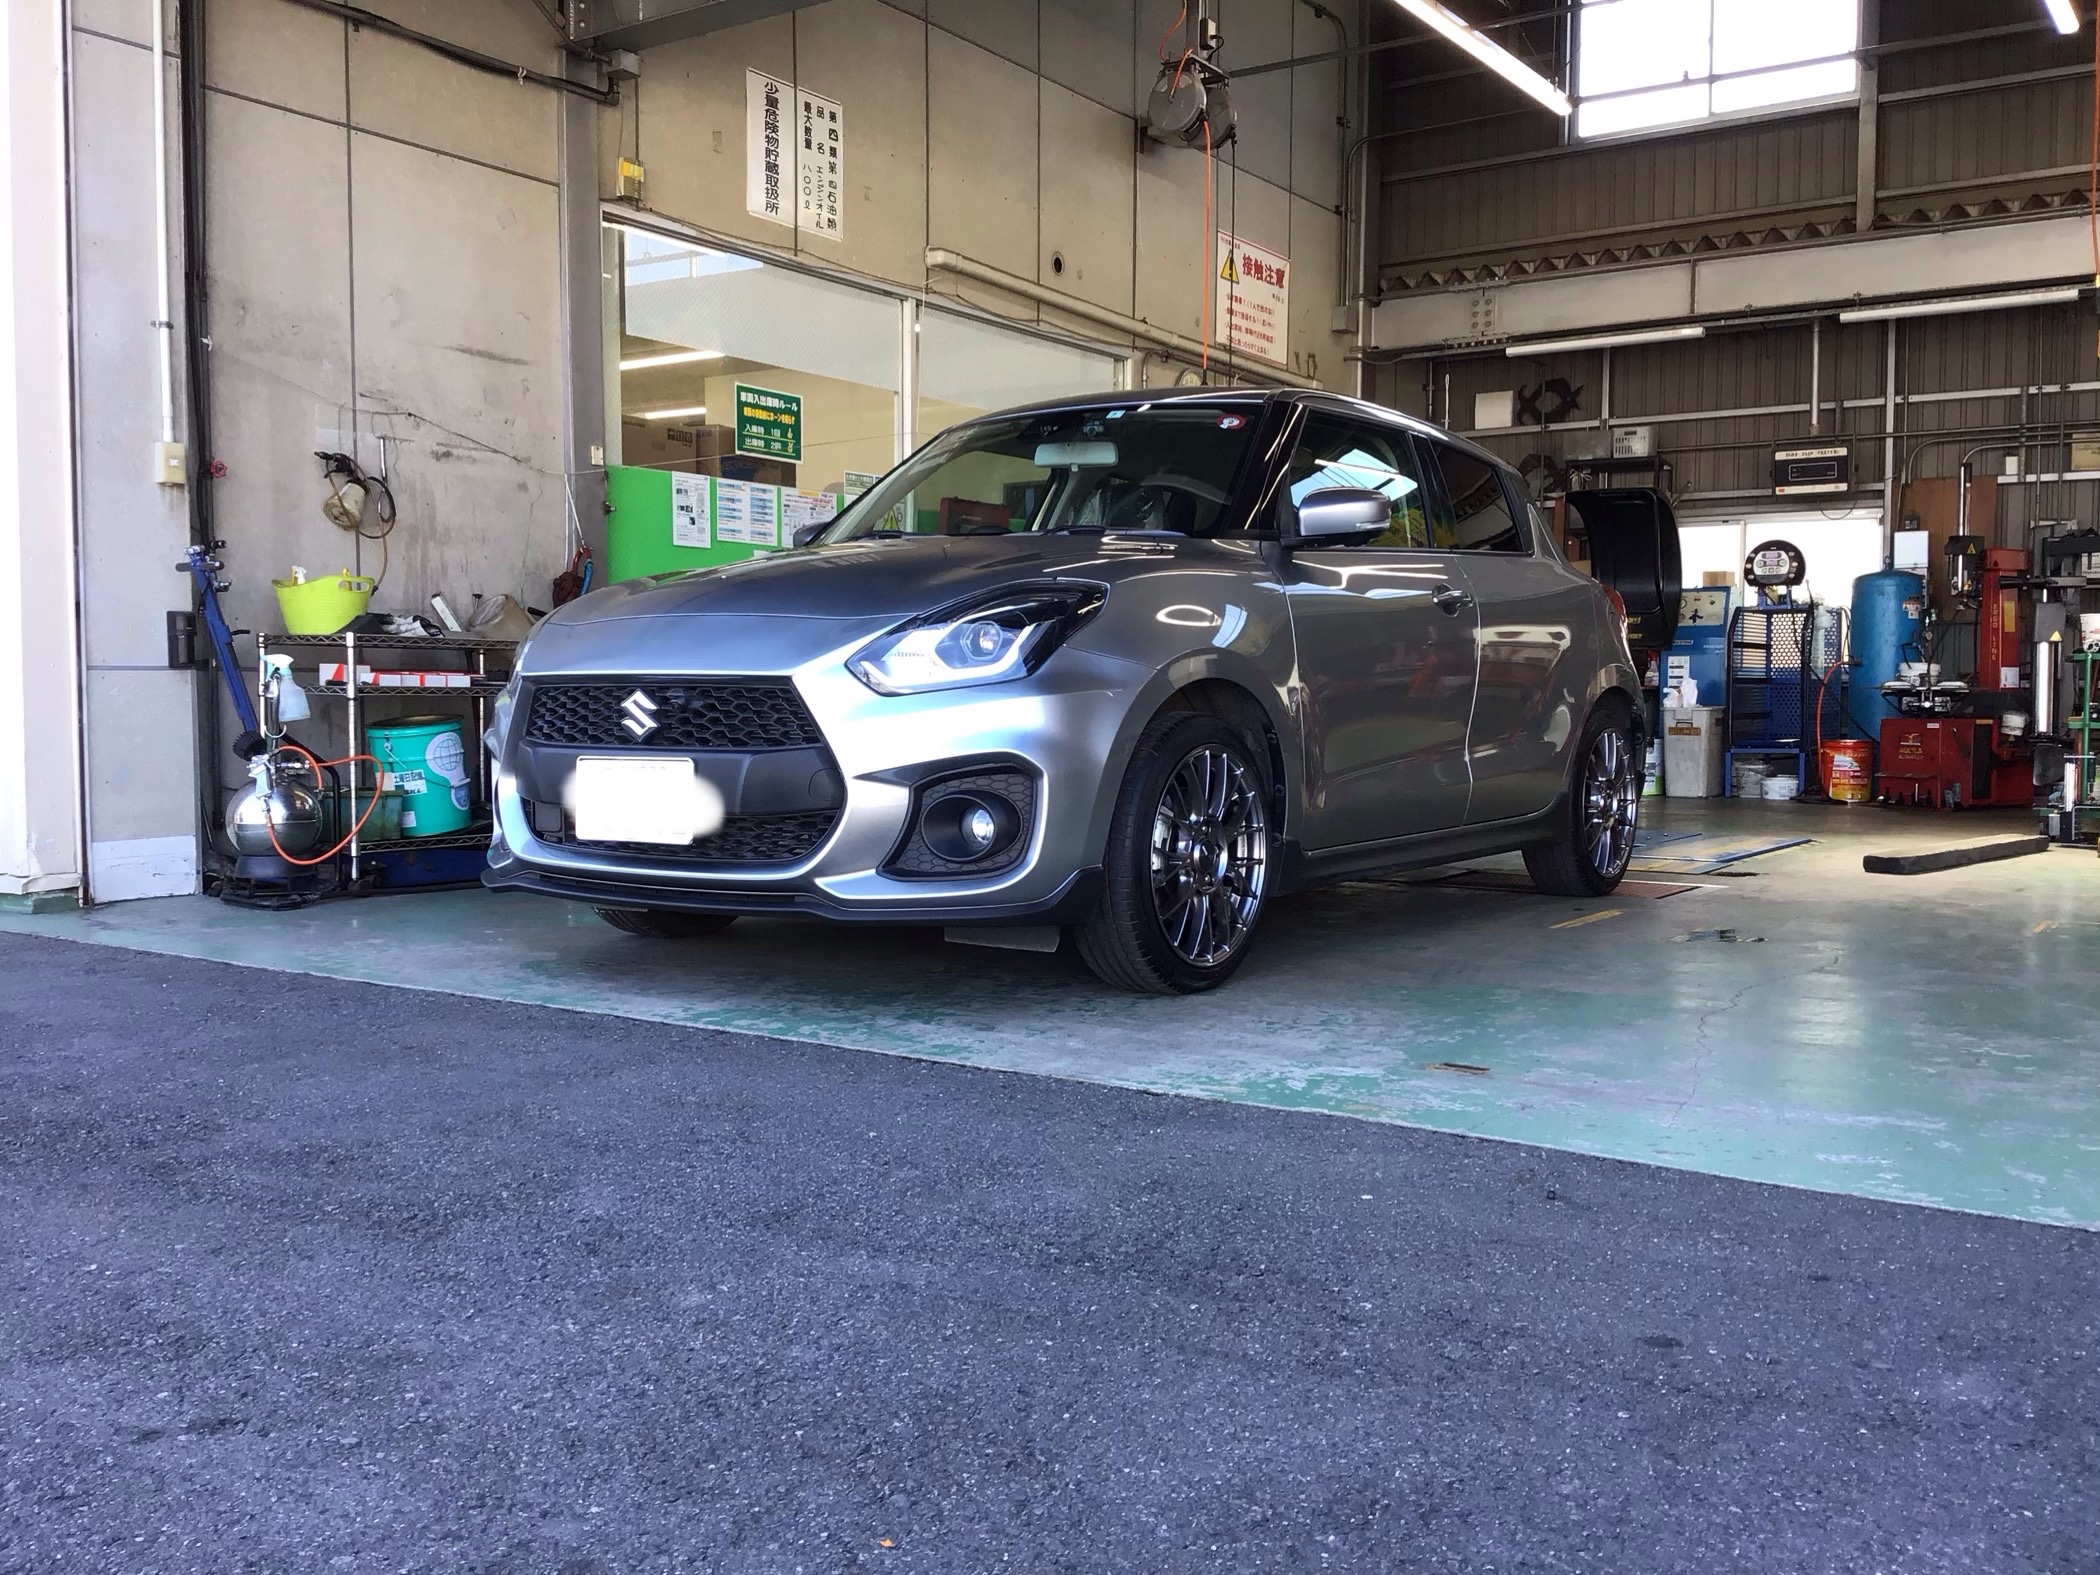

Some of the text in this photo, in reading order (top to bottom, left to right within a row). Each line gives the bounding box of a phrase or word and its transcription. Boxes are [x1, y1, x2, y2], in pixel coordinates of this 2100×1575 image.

[764, 82, 780, 216] 少量危険物貯蔵取扱所
[803, 100, 813, 151] 最大数量
[1242, 254, 1286, 288] 接触注意
